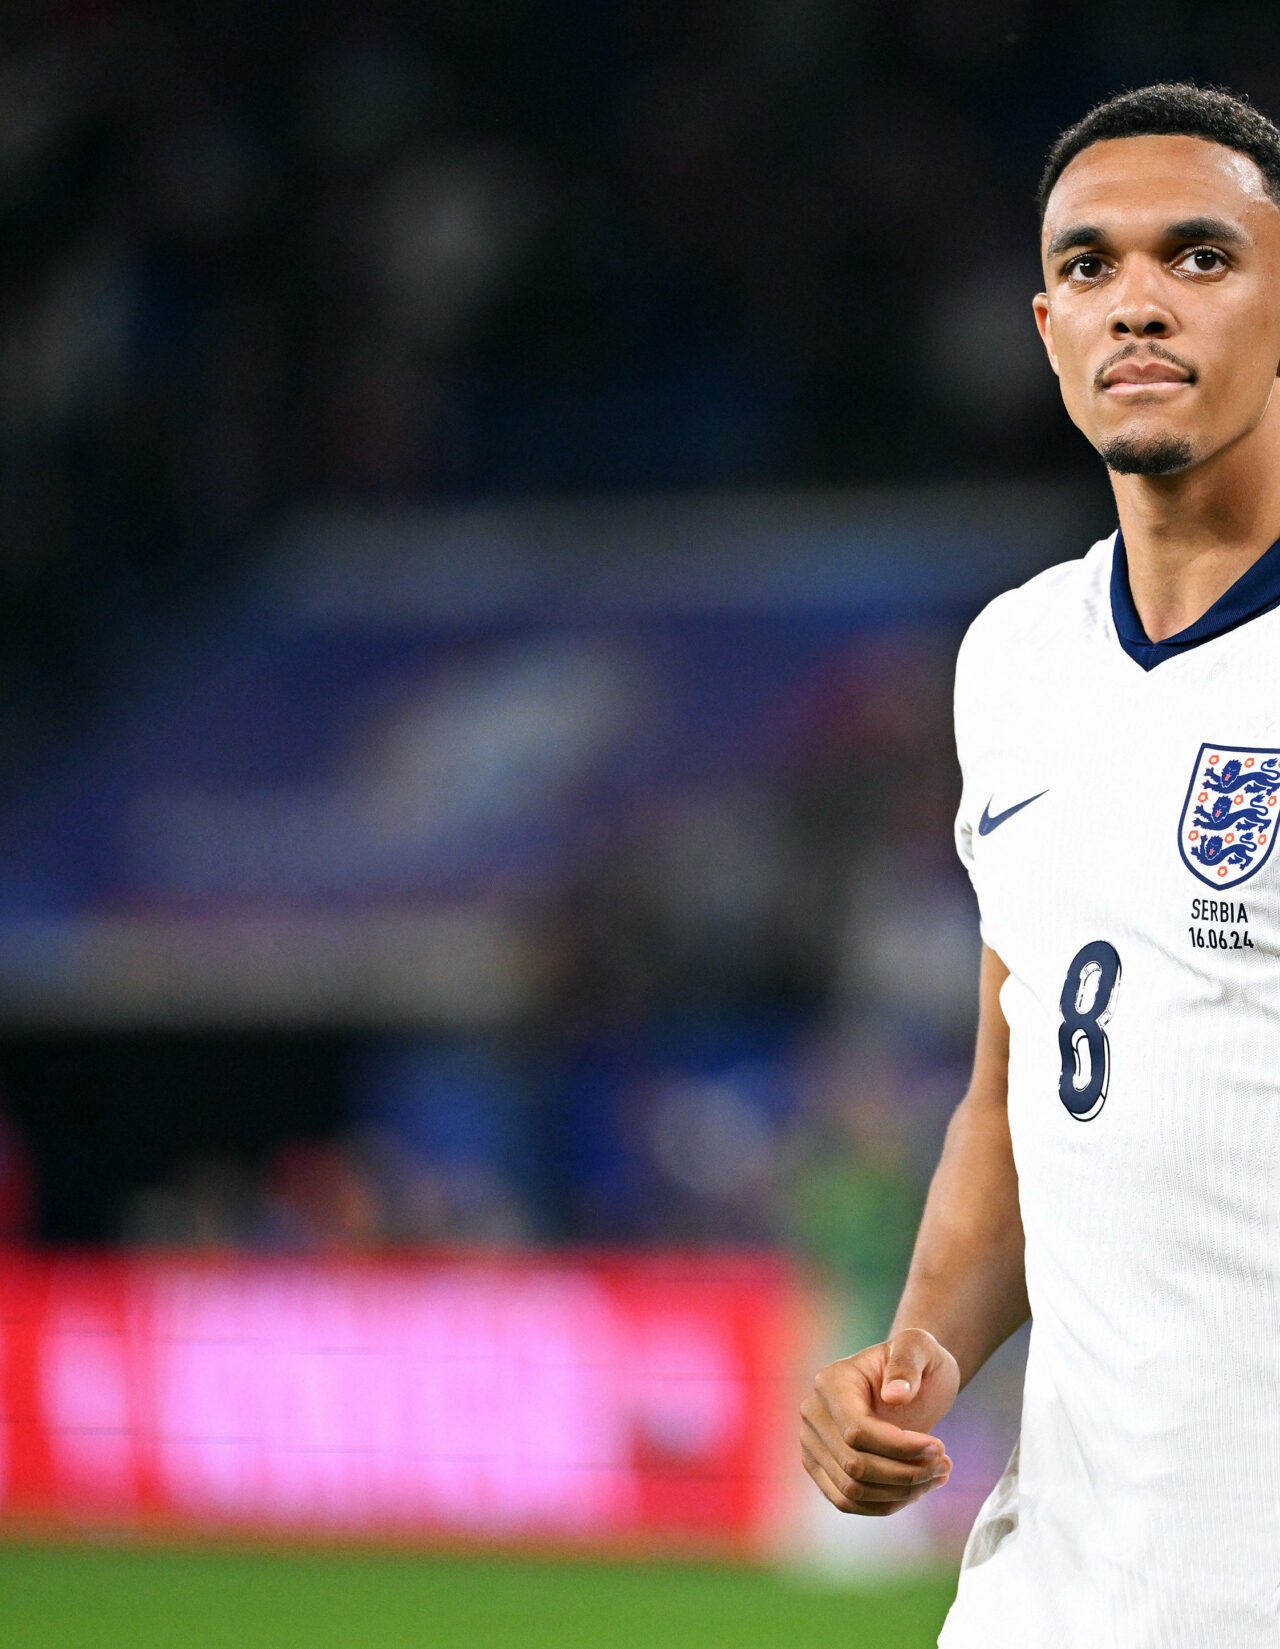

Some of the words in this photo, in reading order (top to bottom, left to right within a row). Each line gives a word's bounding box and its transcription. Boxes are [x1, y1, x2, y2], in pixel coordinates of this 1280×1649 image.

[1190, 898, 1249, 923] SERBIA
[1188, 927, 1255, 950] 16.06.24
[1058, 940, 1123, 1122] 8
